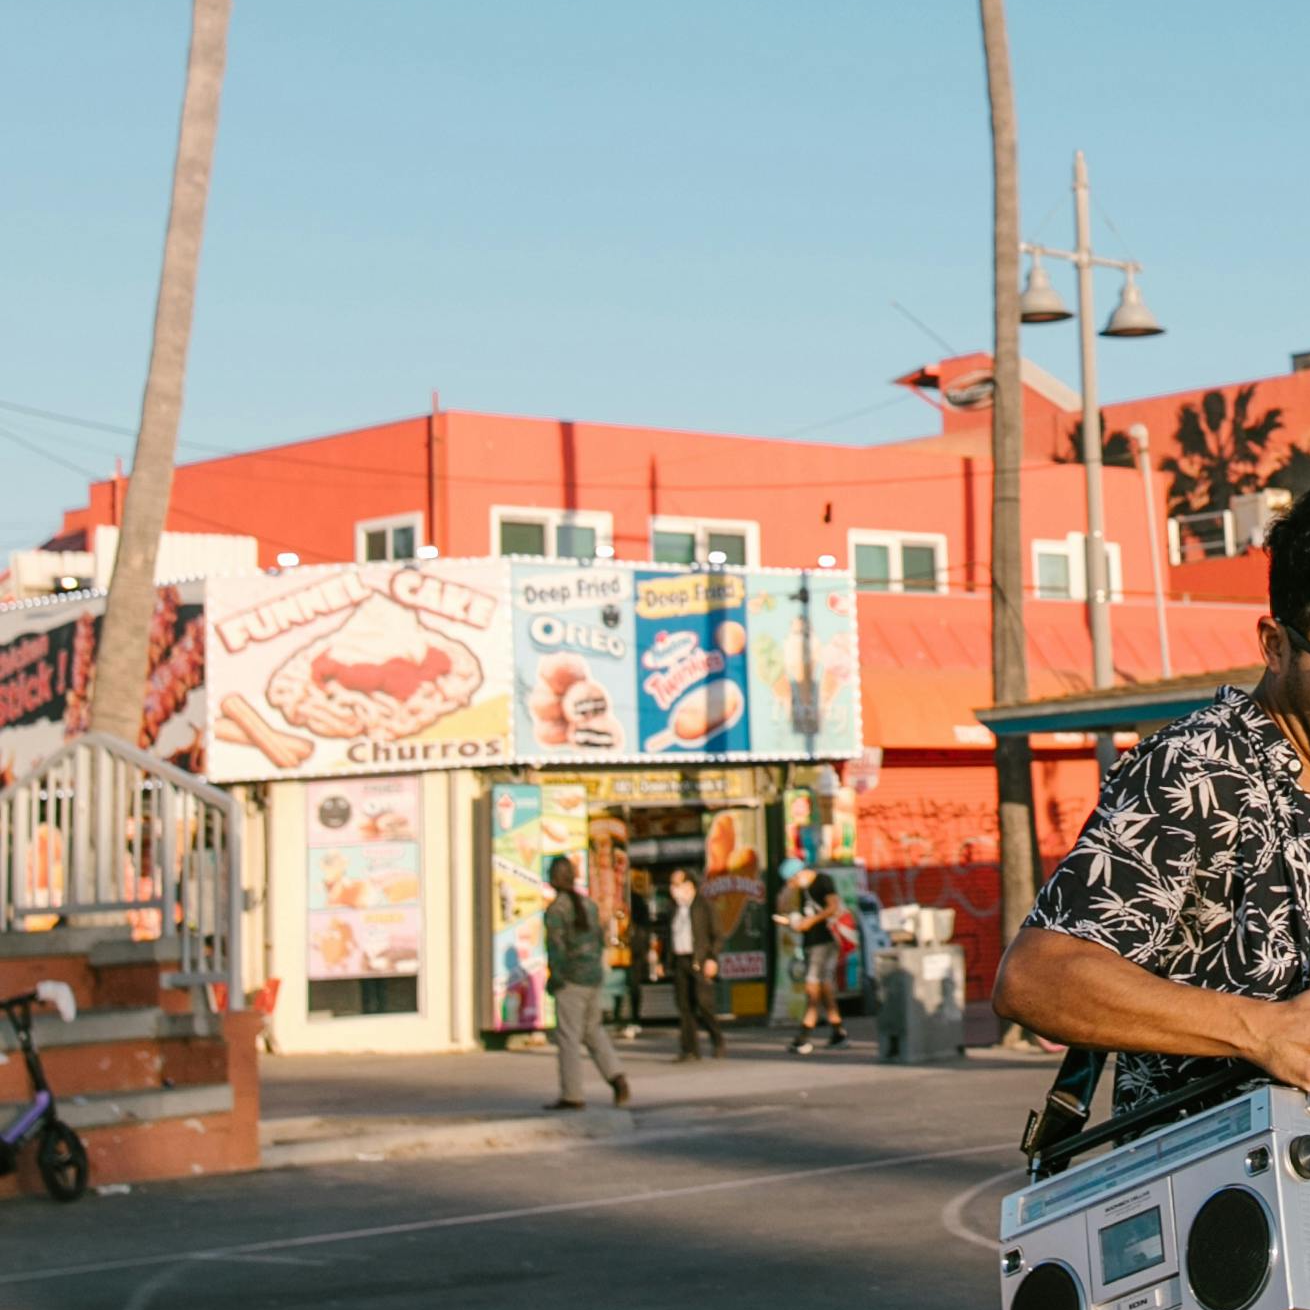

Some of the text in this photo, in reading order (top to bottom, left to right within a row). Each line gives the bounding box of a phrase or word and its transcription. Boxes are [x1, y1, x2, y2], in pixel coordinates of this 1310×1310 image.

[525, 577, 621, 605] Deep Fried
[645, 589, 689, 609] Deep
[214, 569, 498, 655] FUNNEL CAKE
[530, 614, 626, 659] OREO
[347, 738, 501, 764] Churros
